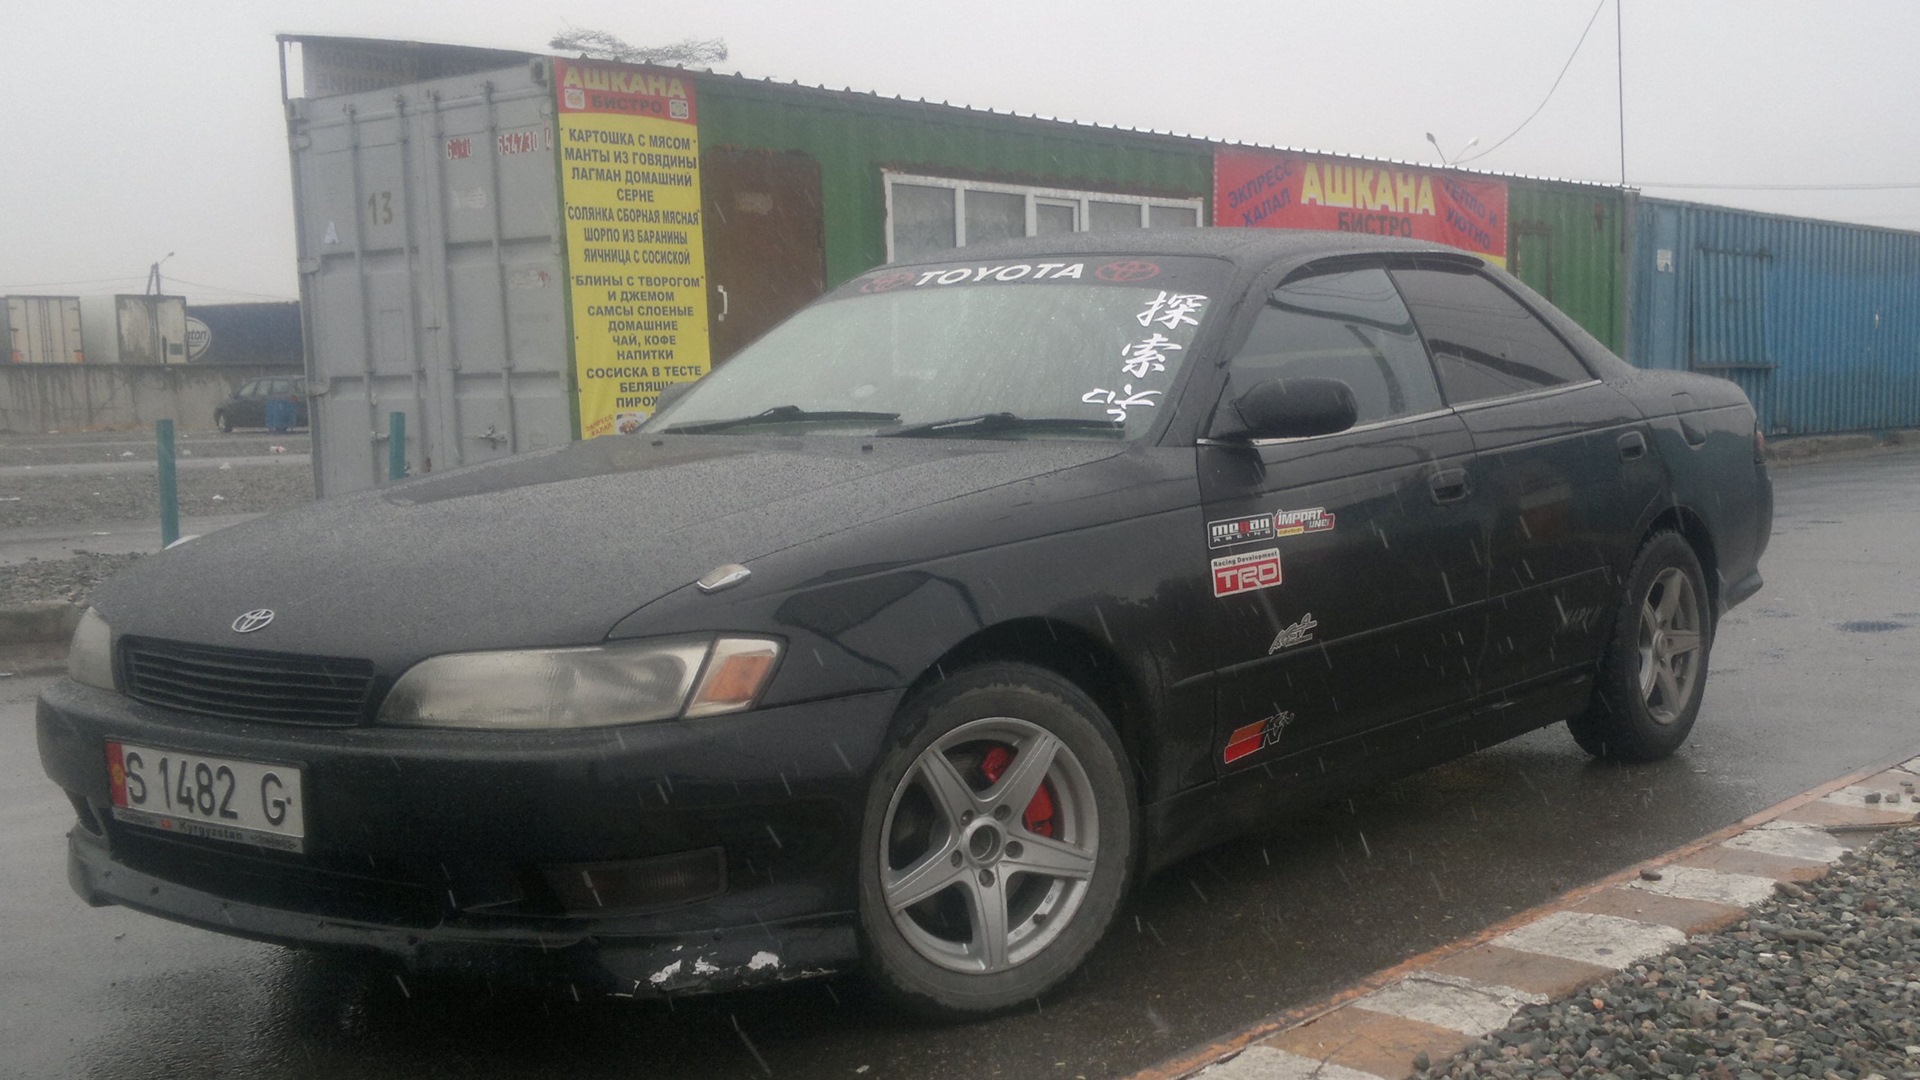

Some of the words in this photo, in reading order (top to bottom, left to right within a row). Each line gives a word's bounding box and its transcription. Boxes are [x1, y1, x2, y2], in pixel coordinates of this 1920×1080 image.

[563, 66, 687, 98] АШКАНА
[591, 95, 663, 114] БИСТРО
[569, 128, 635, 146] КАРТОШКА
[638, 135, 645, 146] С
[649, 135, 690, 150] МЯСОМ
[565, 147, 610, 163] МАНТЫ
[613, 151, 629, 164] ИЗ
[632, 152, 697, 169] ГОВЯДИНЫ
[571, 167, 621, 182] ЛАГМАН
[625, 171, 692, 187] ДОМАШНИЙ
[1301, 161, 1435, 216] АШКАНА
[367, 191, 393, 226] 13
[567, 206, 614, 221] СОЛЯНКА
[617, 208, 660, 223] СБОРНАЯ
[662, 211, 699, 225] МЯСНАЯ
[1337, 211, 1412, 238] БИСТРО
[584, 227, 620, 242] ШОРПО
[622, 230, 635, 243] ИЗ
[637, 231, 688, 245] БАРАНИНЫ
[584, 249, 631, 265] ЯИЧНИЦА
[634, 250, 640, 264] С
[643, 249, 690, 265] СОСИСКОЙ
[576, 275, 623, 287] БЛИНЫ
[627, 276, 635, 286] С
[638, 276, 700, 288] ТВОРОГОМ
[915, 263, 1084, 286] TOYOTA
[608, 291, 617, 301] И
[620, 291, 675, 303] ДЖЕМОМ
[587, 306, 634, 317] САМСЫ
[637, 306, 694, 317] СЛОЕНЫЕ
[608, 321, 678, 333] ДОМАШНИЕ
[612, 334, 641, 347] ЧАЙ,
[644, 335, 676, 346] КОФЕ
[617, 350, 674, 361] НАПИТКИ
[586, 367, 648, 379] СОСИСКА
[652, 366, 660, 377] В
[664, 366, 701, 377] ТЕСТЕ
[1213, 558, 1236, 568] Racing
[1237, 551, 1278, 564] Development
[1217, 563, 1279, 591] TRD
[126, 752, 147, 804] S
[159, 757, 238, 820] 1482
[261, 772, 286, 826] G
[179, 821, 243, 842] Kyrgyzstan
